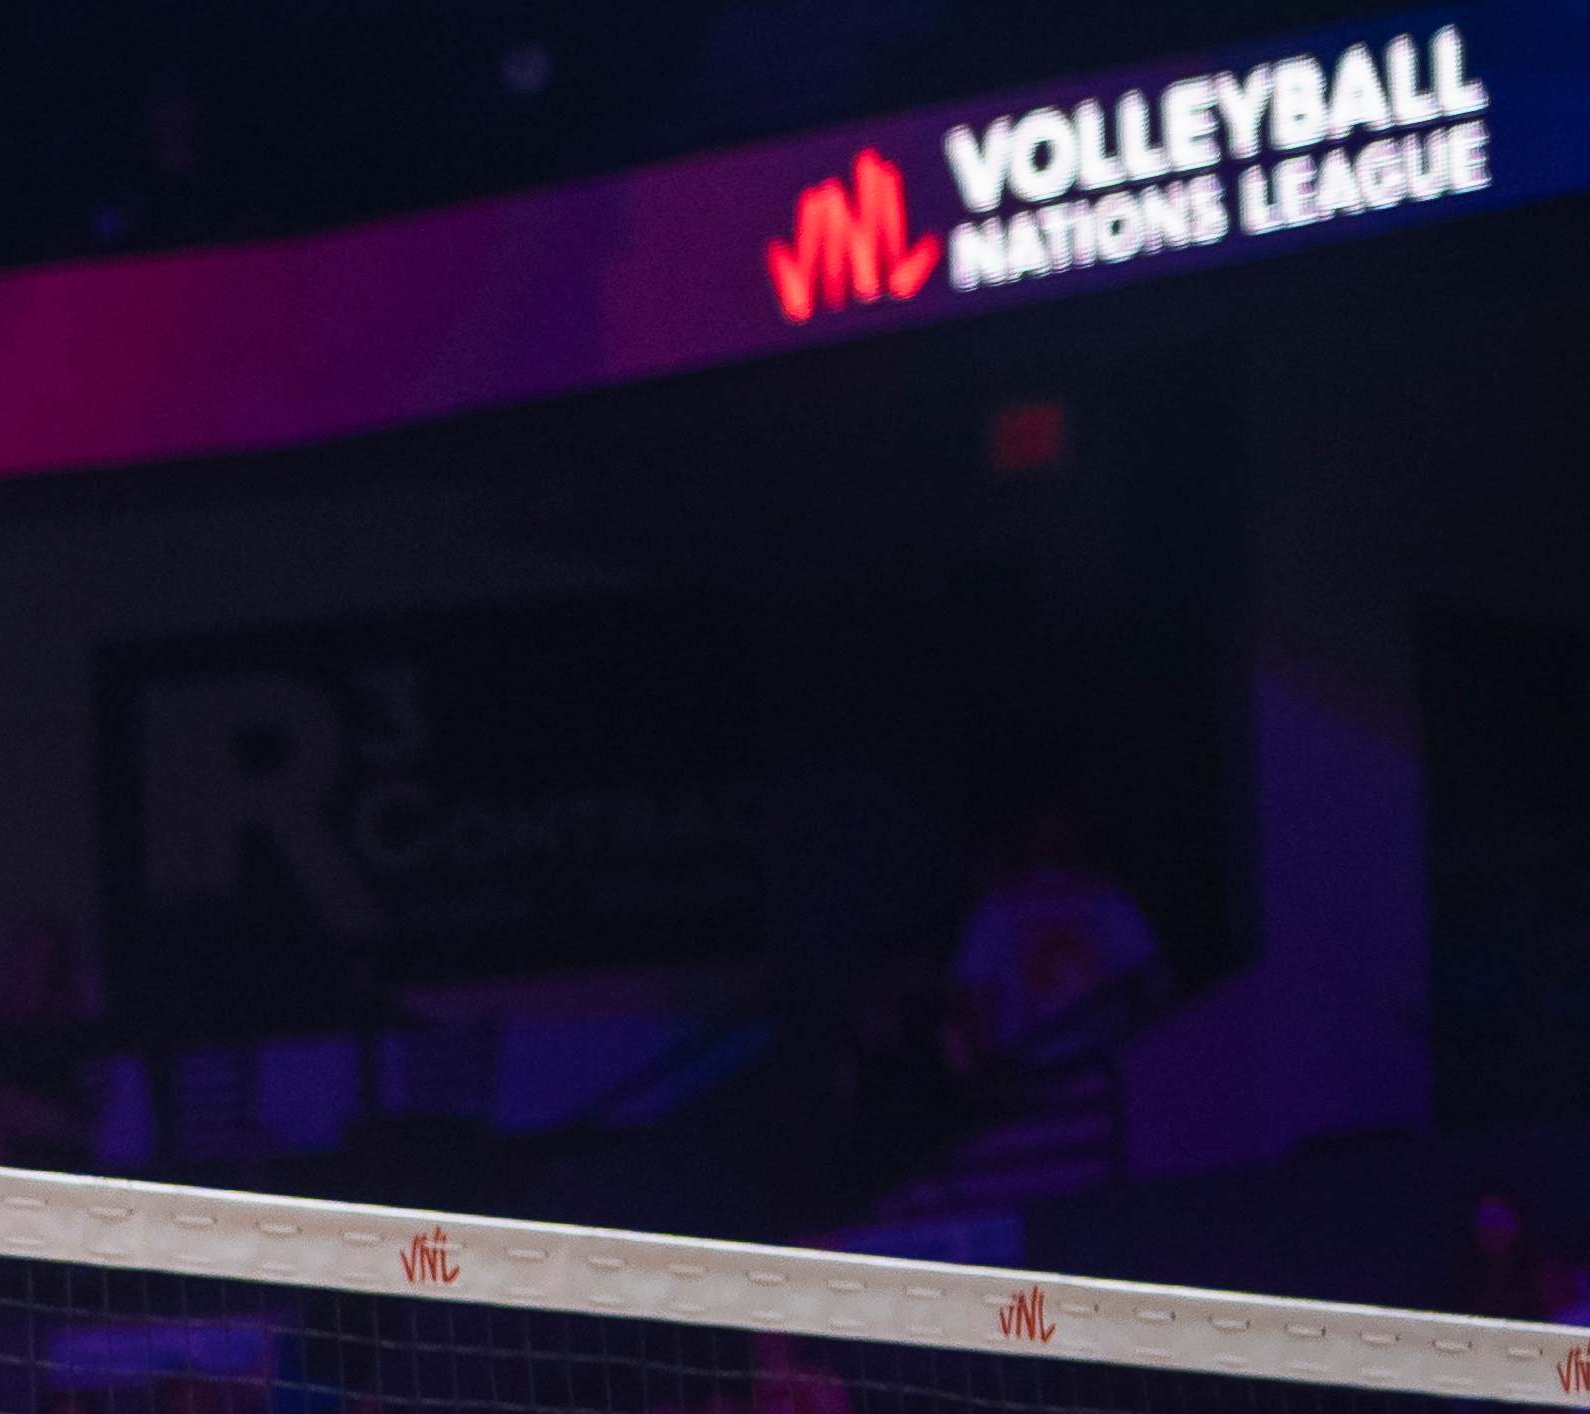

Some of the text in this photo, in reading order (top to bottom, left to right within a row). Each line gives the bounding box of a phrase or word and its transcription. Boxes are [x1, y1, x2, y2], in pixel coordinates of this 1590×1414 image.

[944, 23, 1491, 214] VOLLEYBALL
[949, 120, 1492, 292] NATIONS LEAGUE
[400, 1226, 460, 1288] VNL
[999, 1287, 1056, 1344] VNL
[1557, 1340, 1590, 1394] VN
